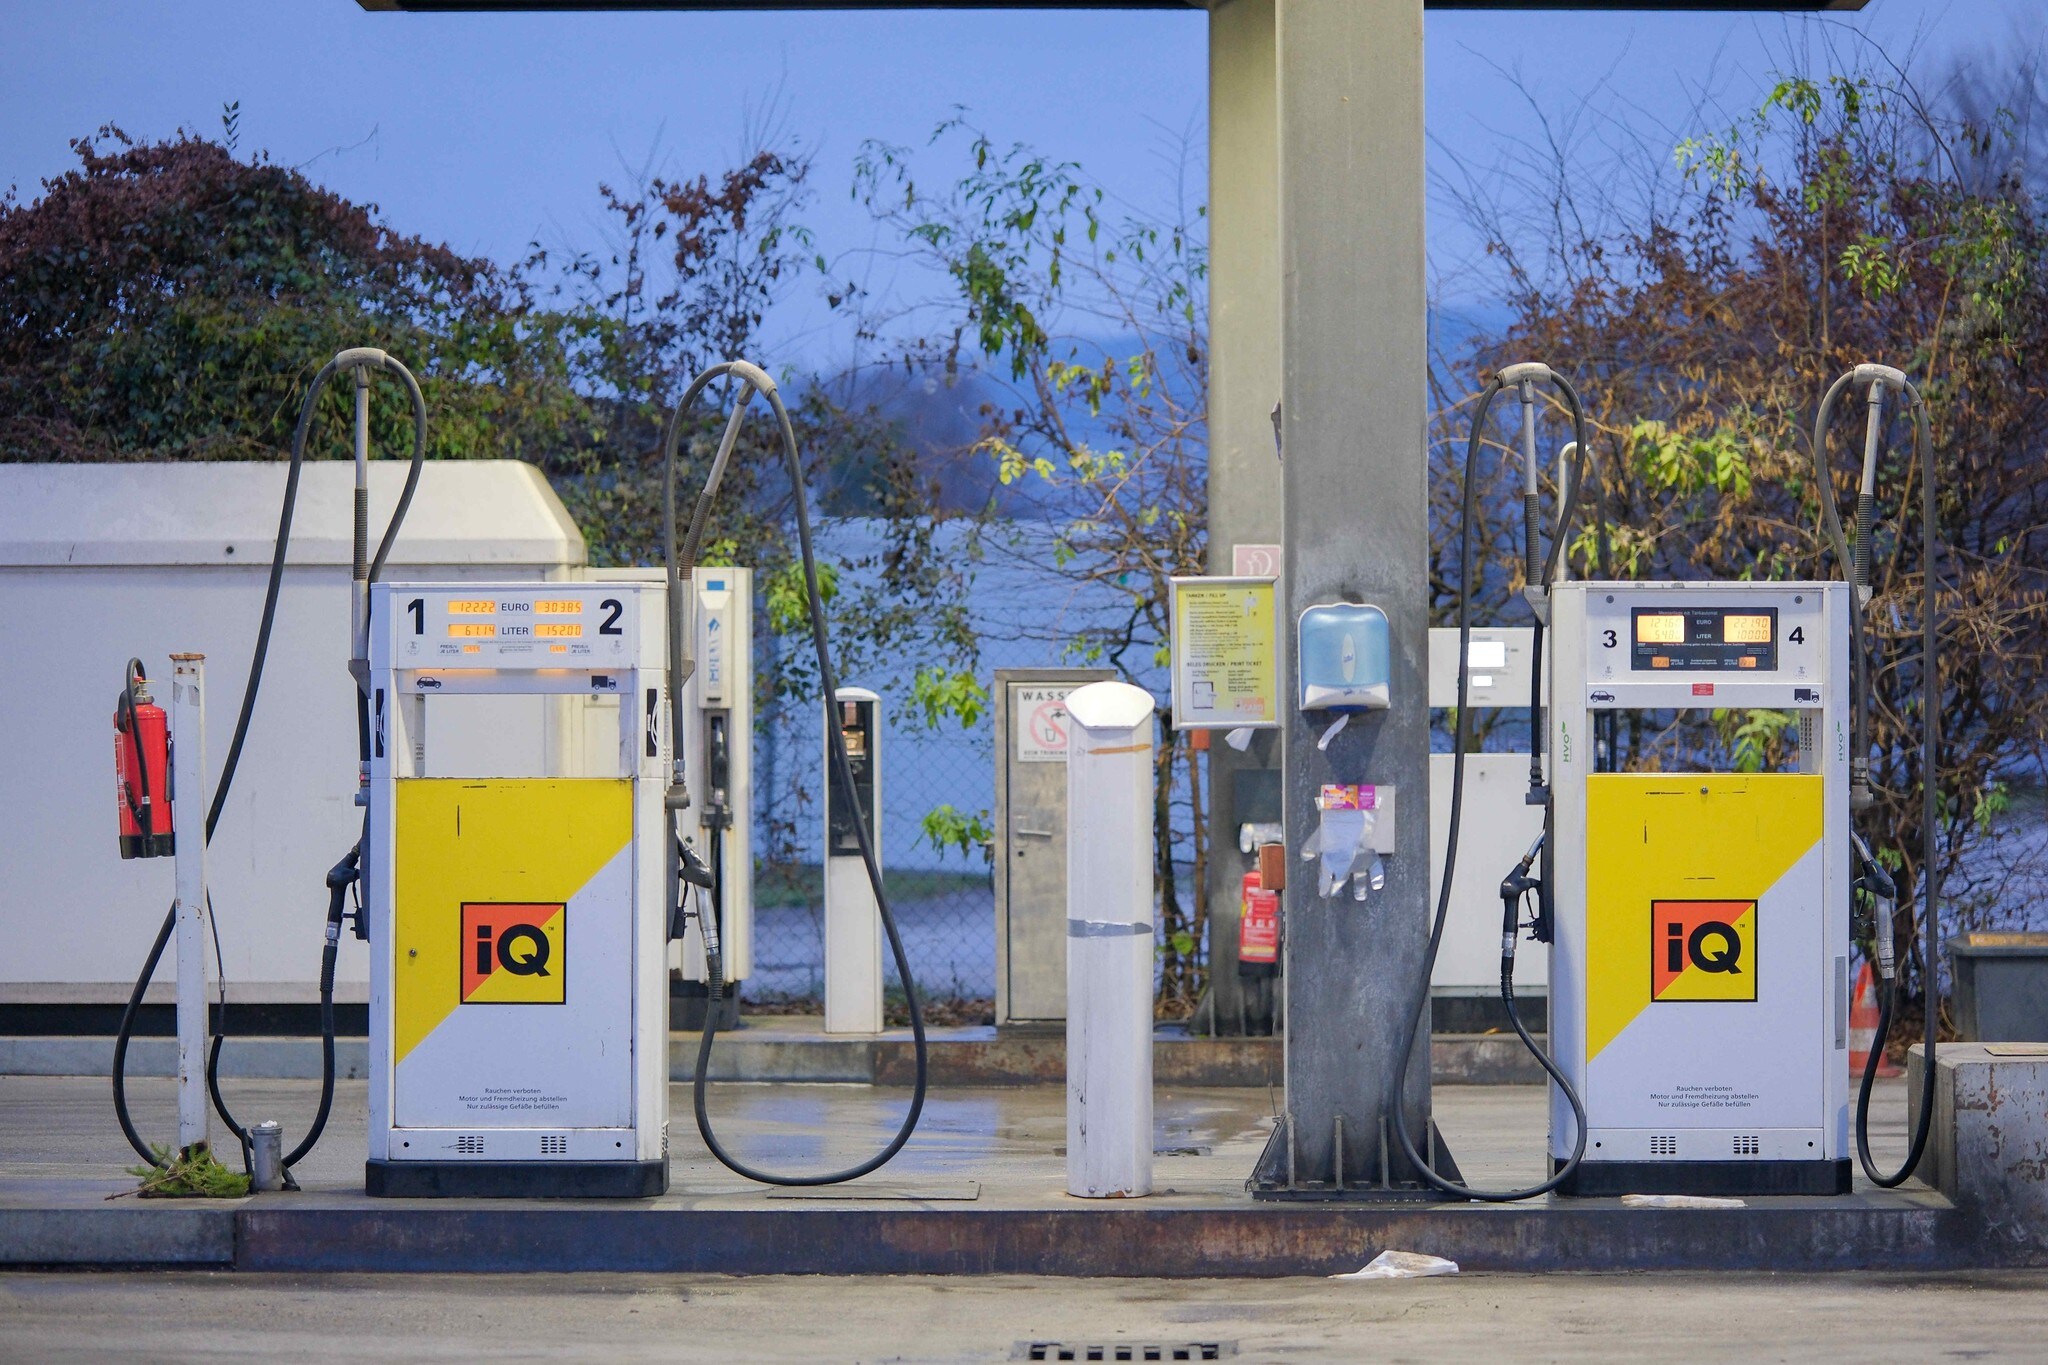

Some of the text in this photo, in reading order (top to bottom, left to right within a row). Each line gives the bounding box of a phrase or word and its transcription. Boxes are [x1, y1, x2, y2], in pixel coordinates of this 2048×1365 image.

[502, 603, 529, 611] EURO
[408, 599, 424, 634] 1
[600, 599, 622, 635] 2
[502, 627, 528, 635] LITER
[1603, 630, 1617, 648] 3
[1789, 627, 1804, 645] 4
[1023, 692, 1074, 701] WASS
[477, 924, 551, 977] iQ
[1668, 921, 1742, 974] iQ
